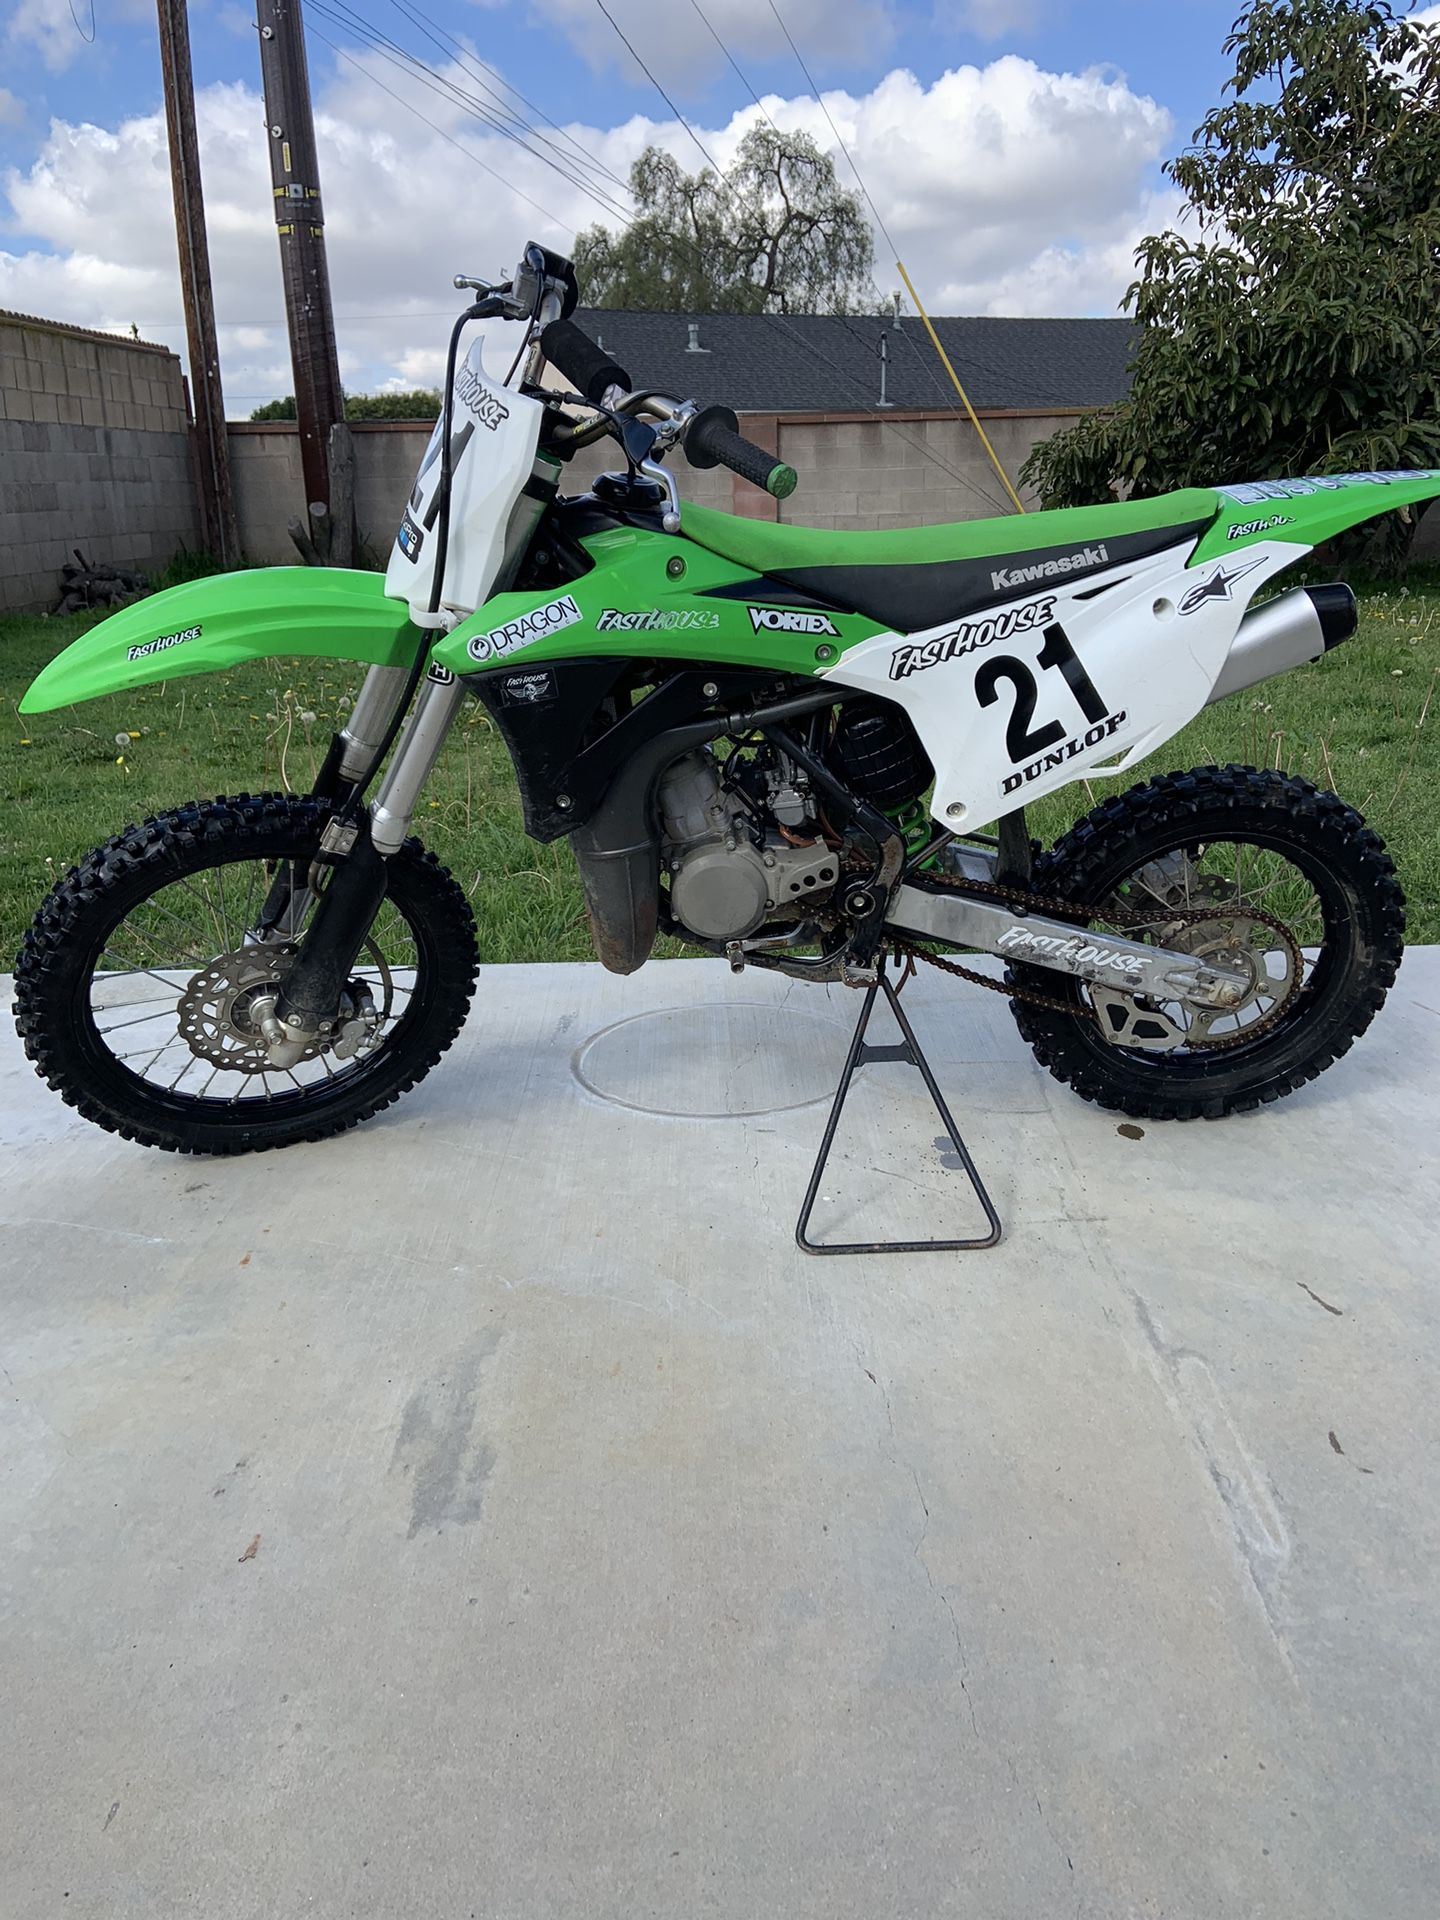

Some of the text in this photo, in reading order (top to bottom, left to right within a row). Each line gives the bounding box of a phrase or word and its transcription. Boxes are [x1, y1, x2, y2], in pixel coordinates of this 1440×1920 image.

[991, 544, 1109, 590] Kawasaki
[127, 624, 203, 662] FASTHOUSE
[490, 597, 578, 650] DRAGON
[596, 607, 720, 632] FASTHOUSE
[746, 605, 843, 637] VORTEX
[889, 596, 1057, 680] FASTHOUSE
[974, 622, 1109, 764] 21
[1003, 711, 1126, 795] DUNLOP
[998, 926, 1153, 974] FASTHOUSE
